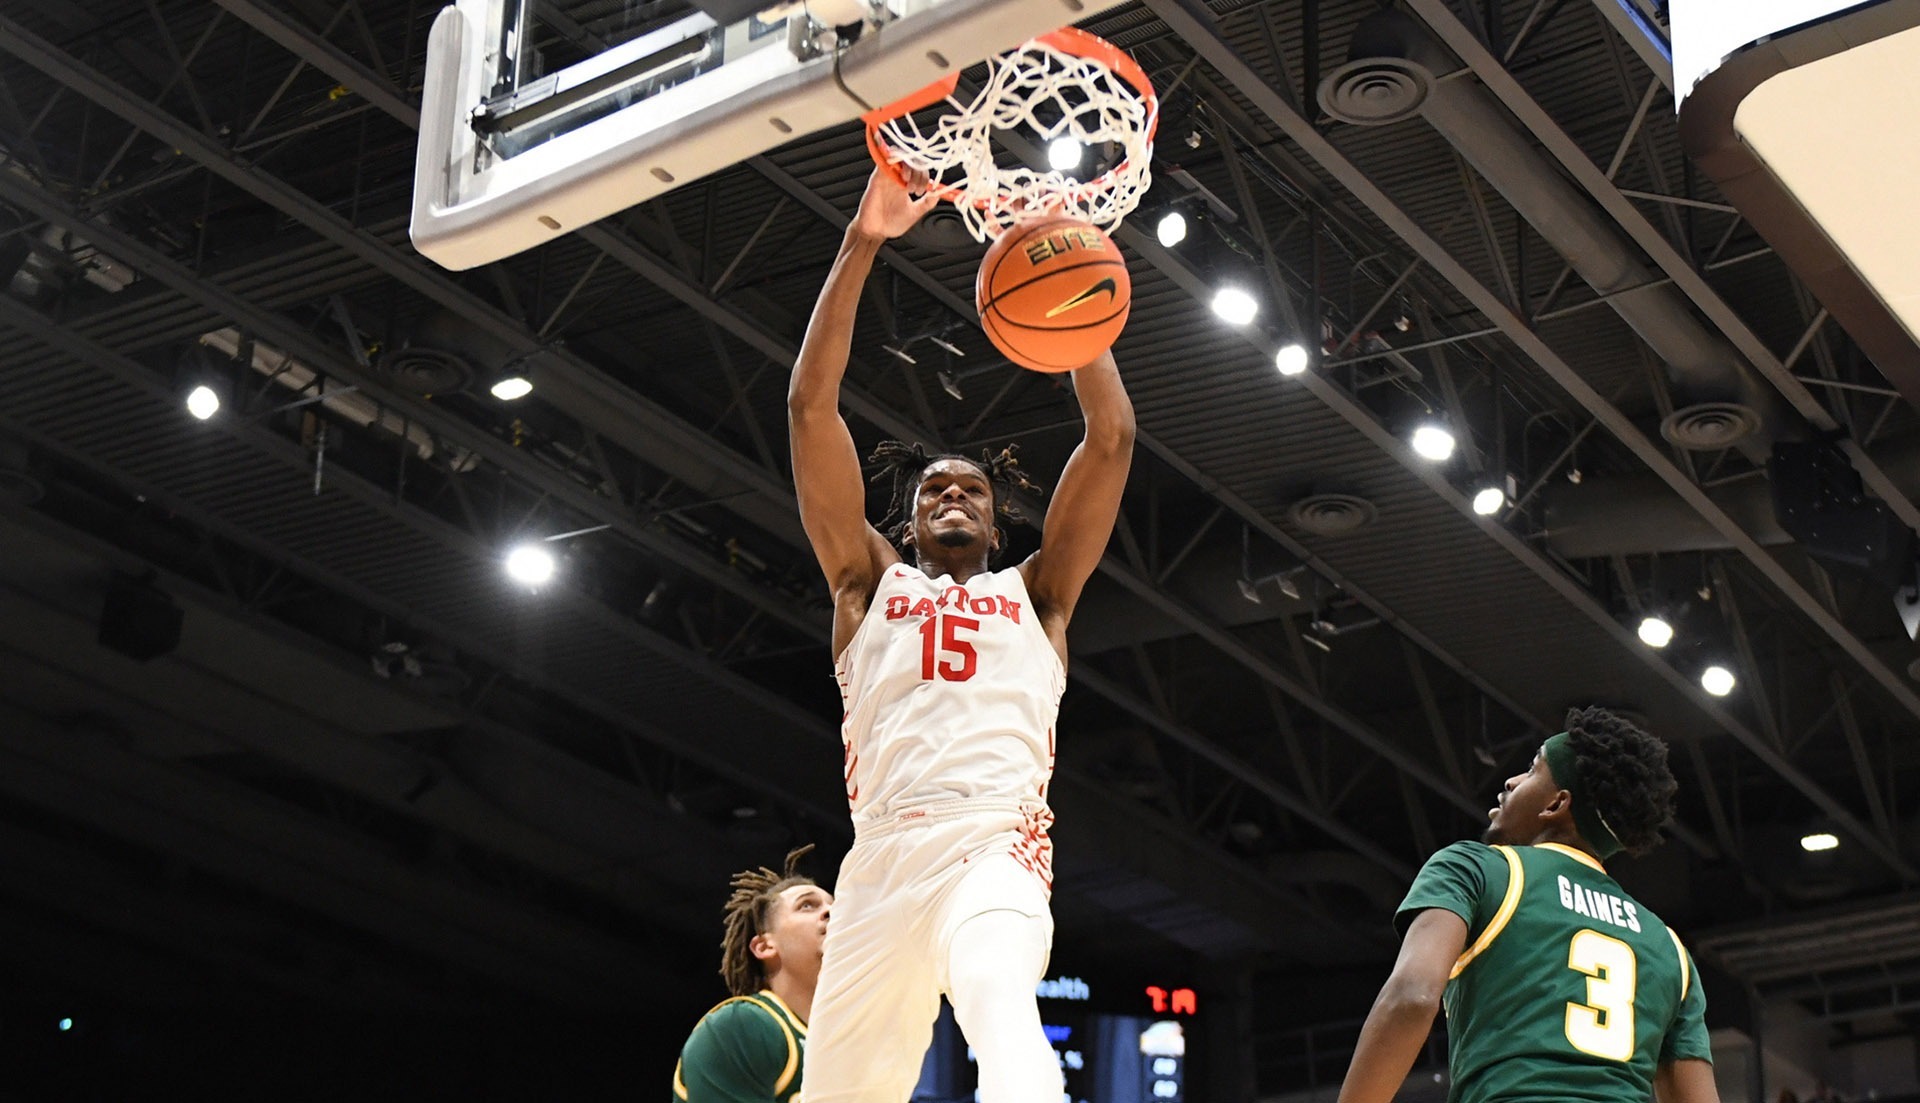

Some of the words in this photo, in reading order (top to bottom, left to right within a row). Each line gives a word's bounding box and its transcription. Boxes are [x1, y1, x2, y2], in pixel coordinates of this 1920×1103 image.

[1023, 227, 1106, 266] ELITE
[885, 585, 1021, 625] DAYTON
[919, 614, 980, 682] 15
[1557, 874, 1642, 934] GAINES
[1564, 928, 1636, 1063] 3
